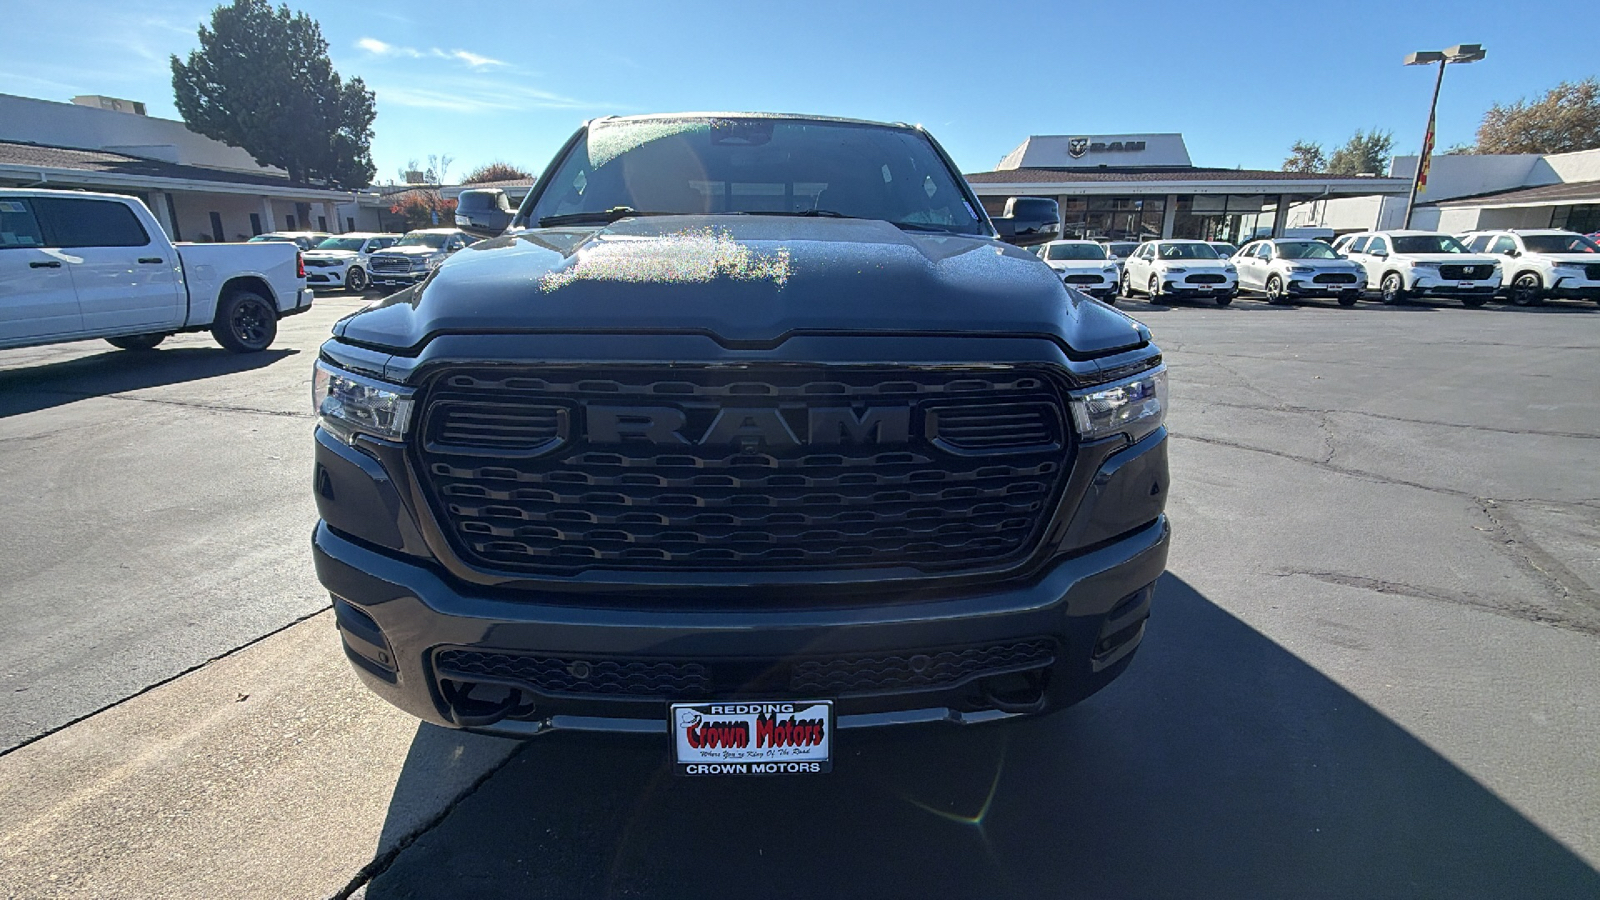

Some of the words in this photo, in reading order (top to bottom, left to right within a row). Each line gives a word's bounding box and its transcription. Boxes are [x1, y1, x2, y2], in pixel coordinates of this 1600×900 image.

[1090, 142, 1146, 152] RAM
[586, 404, 910, 446] RAM
[711, 704, 794, 714] REDDING
[686, 715, 750, 749] Crown
[756, 713, 825, 749] Motors
[686, 764, 747, 774] CROWN
[752, 763, 821, 773] MOTORS
